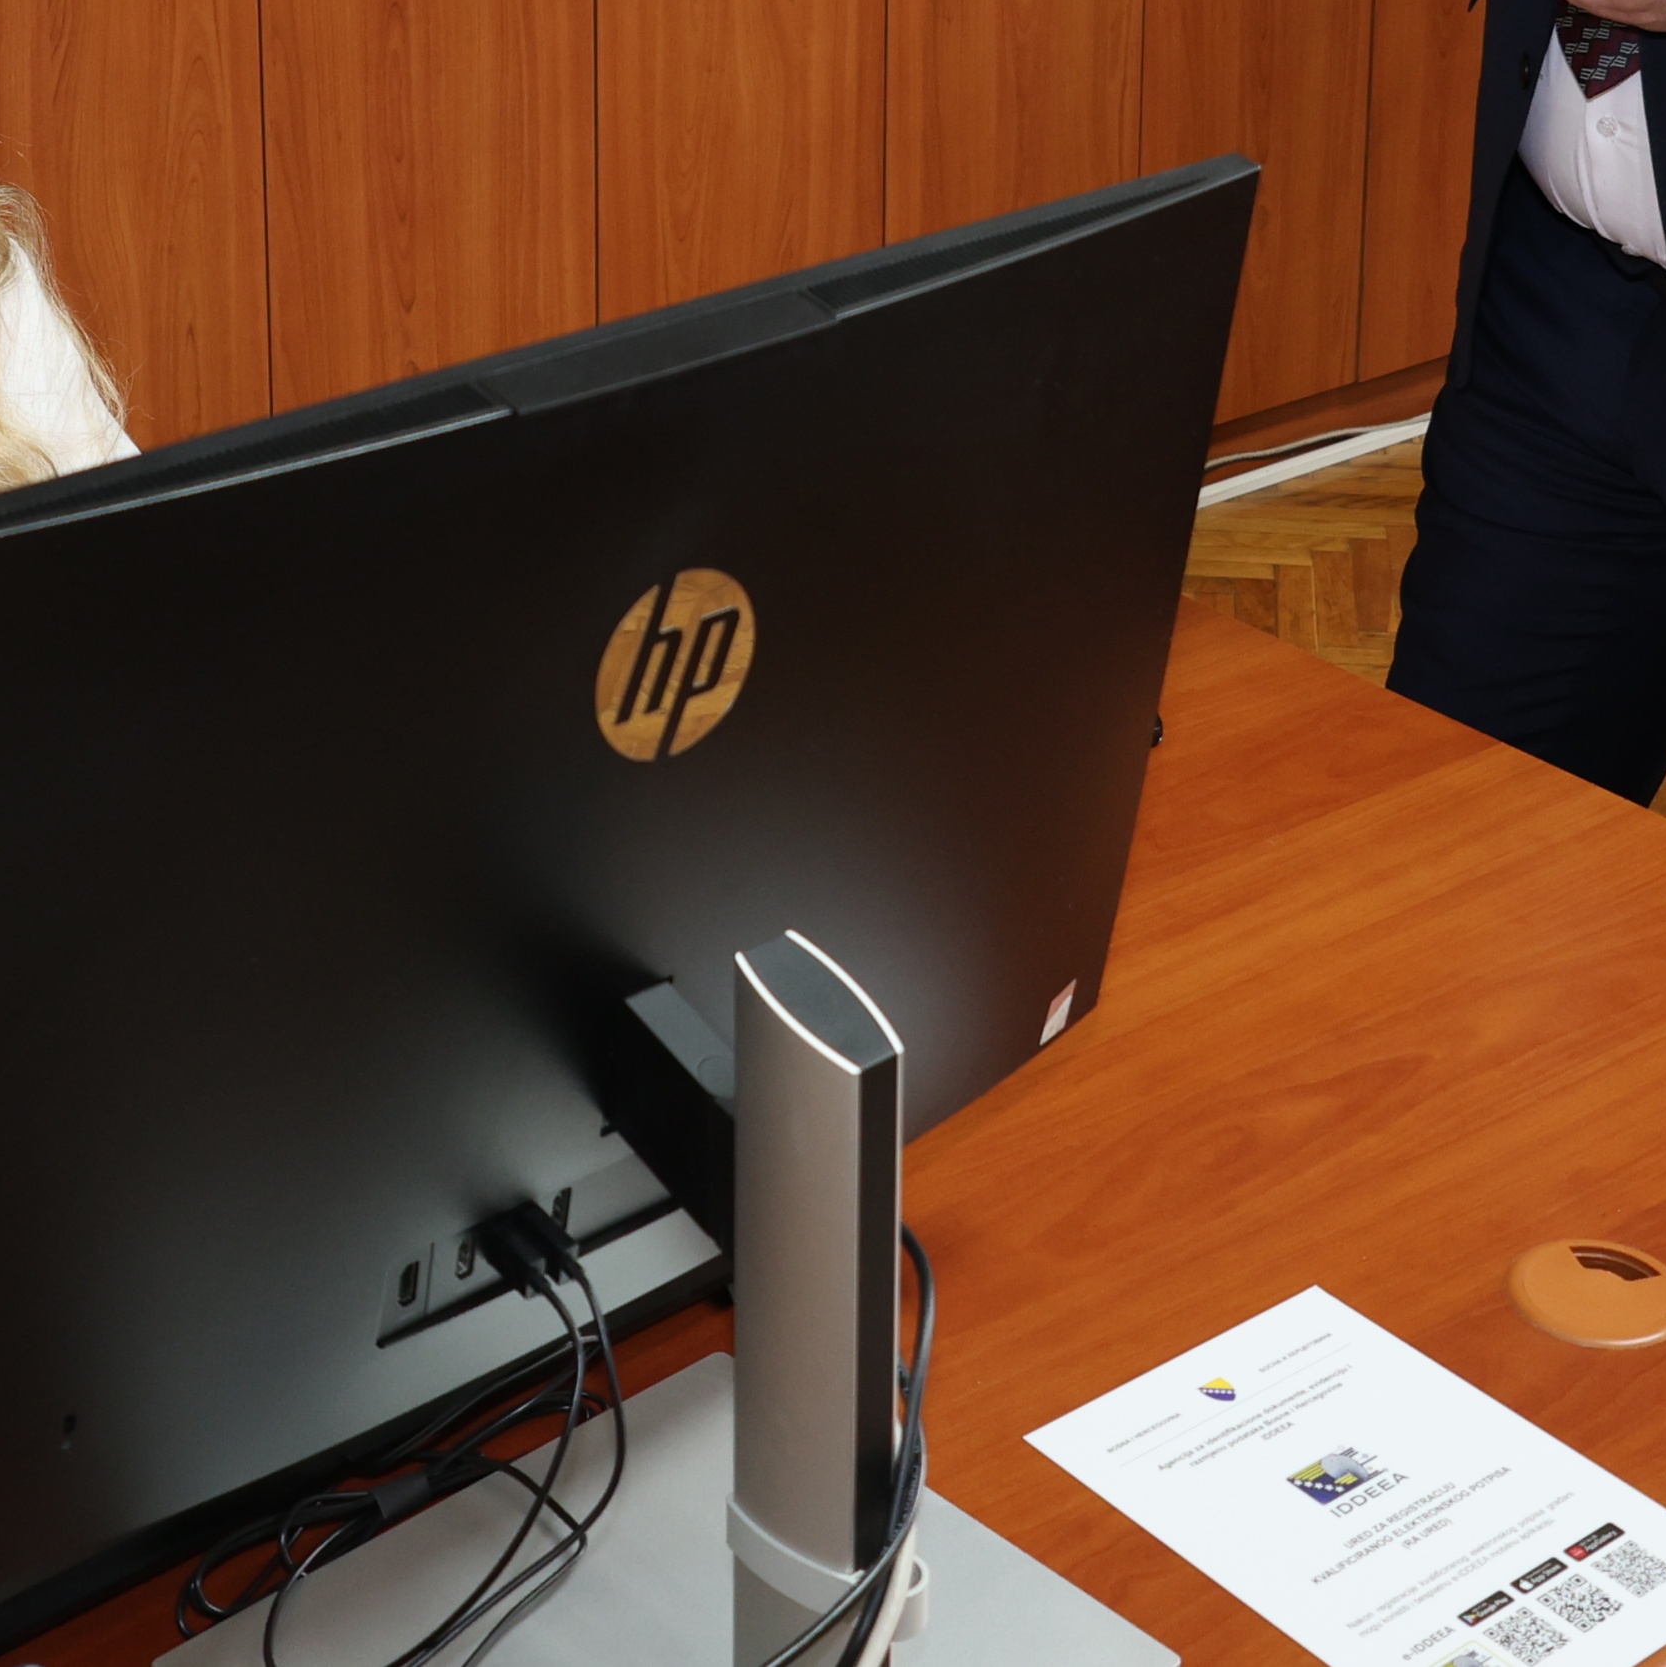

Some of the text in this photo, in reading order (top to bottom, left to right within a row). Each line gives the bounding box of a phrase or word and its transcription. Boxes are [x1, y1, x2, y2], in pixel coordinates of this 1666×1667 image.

[614, 570, 740, 761] hp
[1158, 1450, 1195, 1471] Agencija
[1205, 1413, 1263, 1446] identifikacione
[1263, 1389, 1309, 1414] dokumente,
[1308, 1367, 1348, 1390] evidenciju
[1189, 1445, 1228, 1467] razmjenu
[1227, 1425, 1265, 1448] podataka
[1263, 1411, 1291, 1426] Bosne
[1293, 1382, 1343, 1410] Hercegovine
[1261, 1421, 1294, 1440] IDDEEA
[1311, 1467, 1511, 1585] KVALIFICIRANOG ELEKTRONSKOG POTPISA
[1330, 1473, 1409, 1518] IDDEEA
[1343, 1482, 1456, 1549] URED ZA REGISTRACIJU
[1401, 1518, 1452, 1549] (RA URED)
[1402, 1626, 1456, 1661] e-IDDEEA
